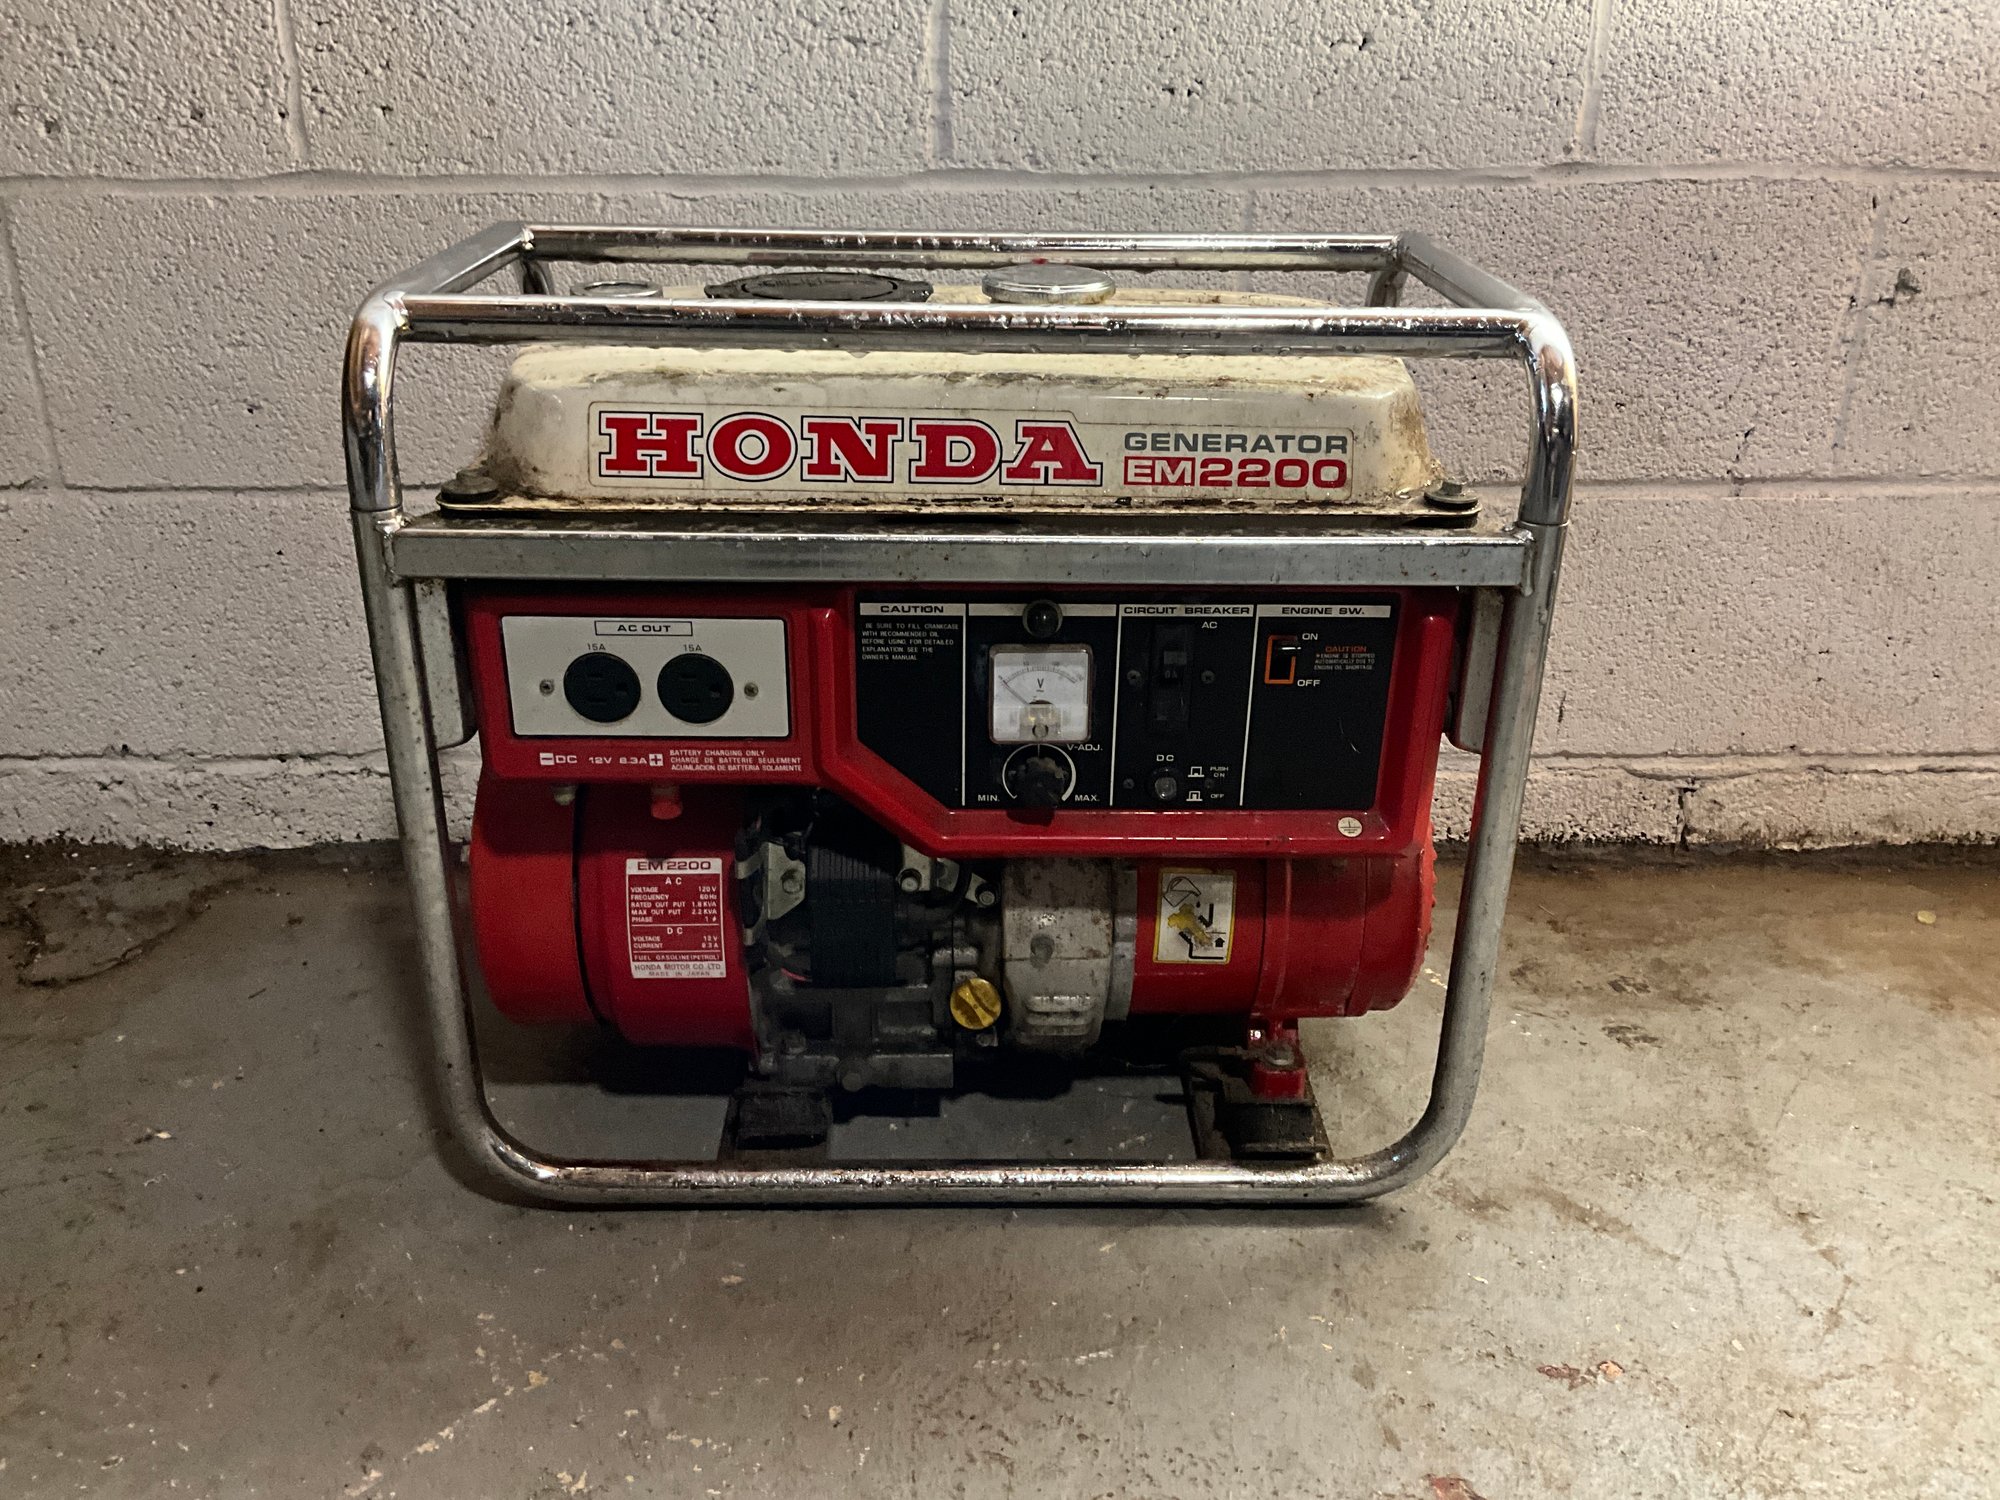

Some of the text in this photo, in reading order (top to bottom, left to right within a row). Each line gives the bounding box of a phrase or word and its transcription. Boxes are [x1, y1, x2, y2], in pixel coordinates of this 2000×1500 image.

[1124, 432, 1348, 454] GENERATOR
[601, 413, 1100, 486] HONDA
[1124, 456, 1348, 488] EM2200
[880, 605, 944, 613] CAUTION
[1123, 606, 1250, 615] CIRCUIT BREAKER
[1281, 607, 1365, 615] ENGINE SW.
[617, 624, 671, 633] AC OUT
[1201, 621, 1218, 629] AC
[880, 630, 928, 638] RECOMMENDED
[587, 643, 606, 651] 15A
[682, 644, 702, 652] 15A
[1325, 645, 1367, 653] CAUTION
[1037, 678, 1045, 689] V
[1067, 743, 1103, 752] V-ADJ.
[705, 749, 742, 757] CHARGING
[746, 749, 765, 757] ONLY
[555, 755, 577, 763] DC
[1156, 754, 1175, 762] DC
[637, 861, 712, 871] EM2200
